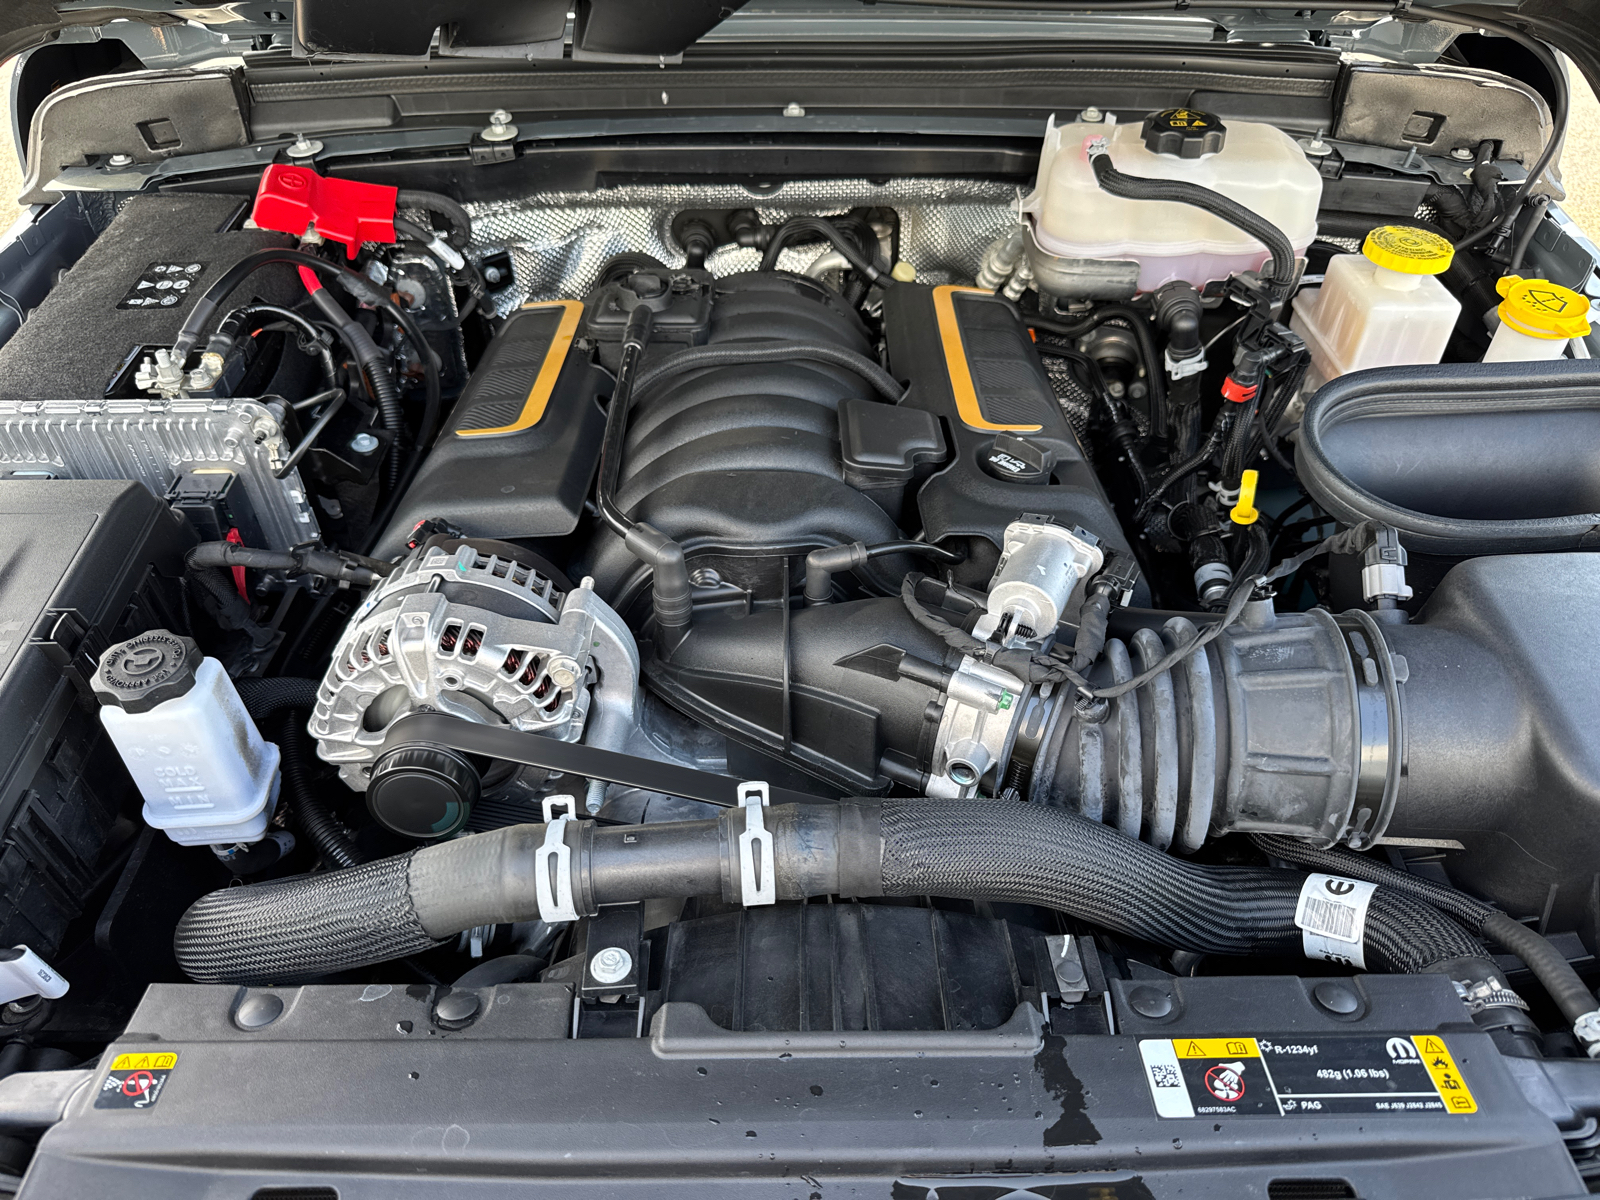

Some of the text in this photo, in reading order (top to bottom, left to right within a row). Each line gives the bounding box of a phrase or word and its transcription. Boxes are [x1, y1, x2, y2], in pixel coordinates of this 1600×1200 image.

[153, 765, 197, 777] COLD
[158, 776, 204, 788] MAX
[168, 794, 211, 806] MIN
[1274, 1044, 1318, 1056] R-1234yf
[1316, 1068, 1390, 1080] 482g (1.06 lbs)
[1300, 1101, 1323, 1110] PAG
